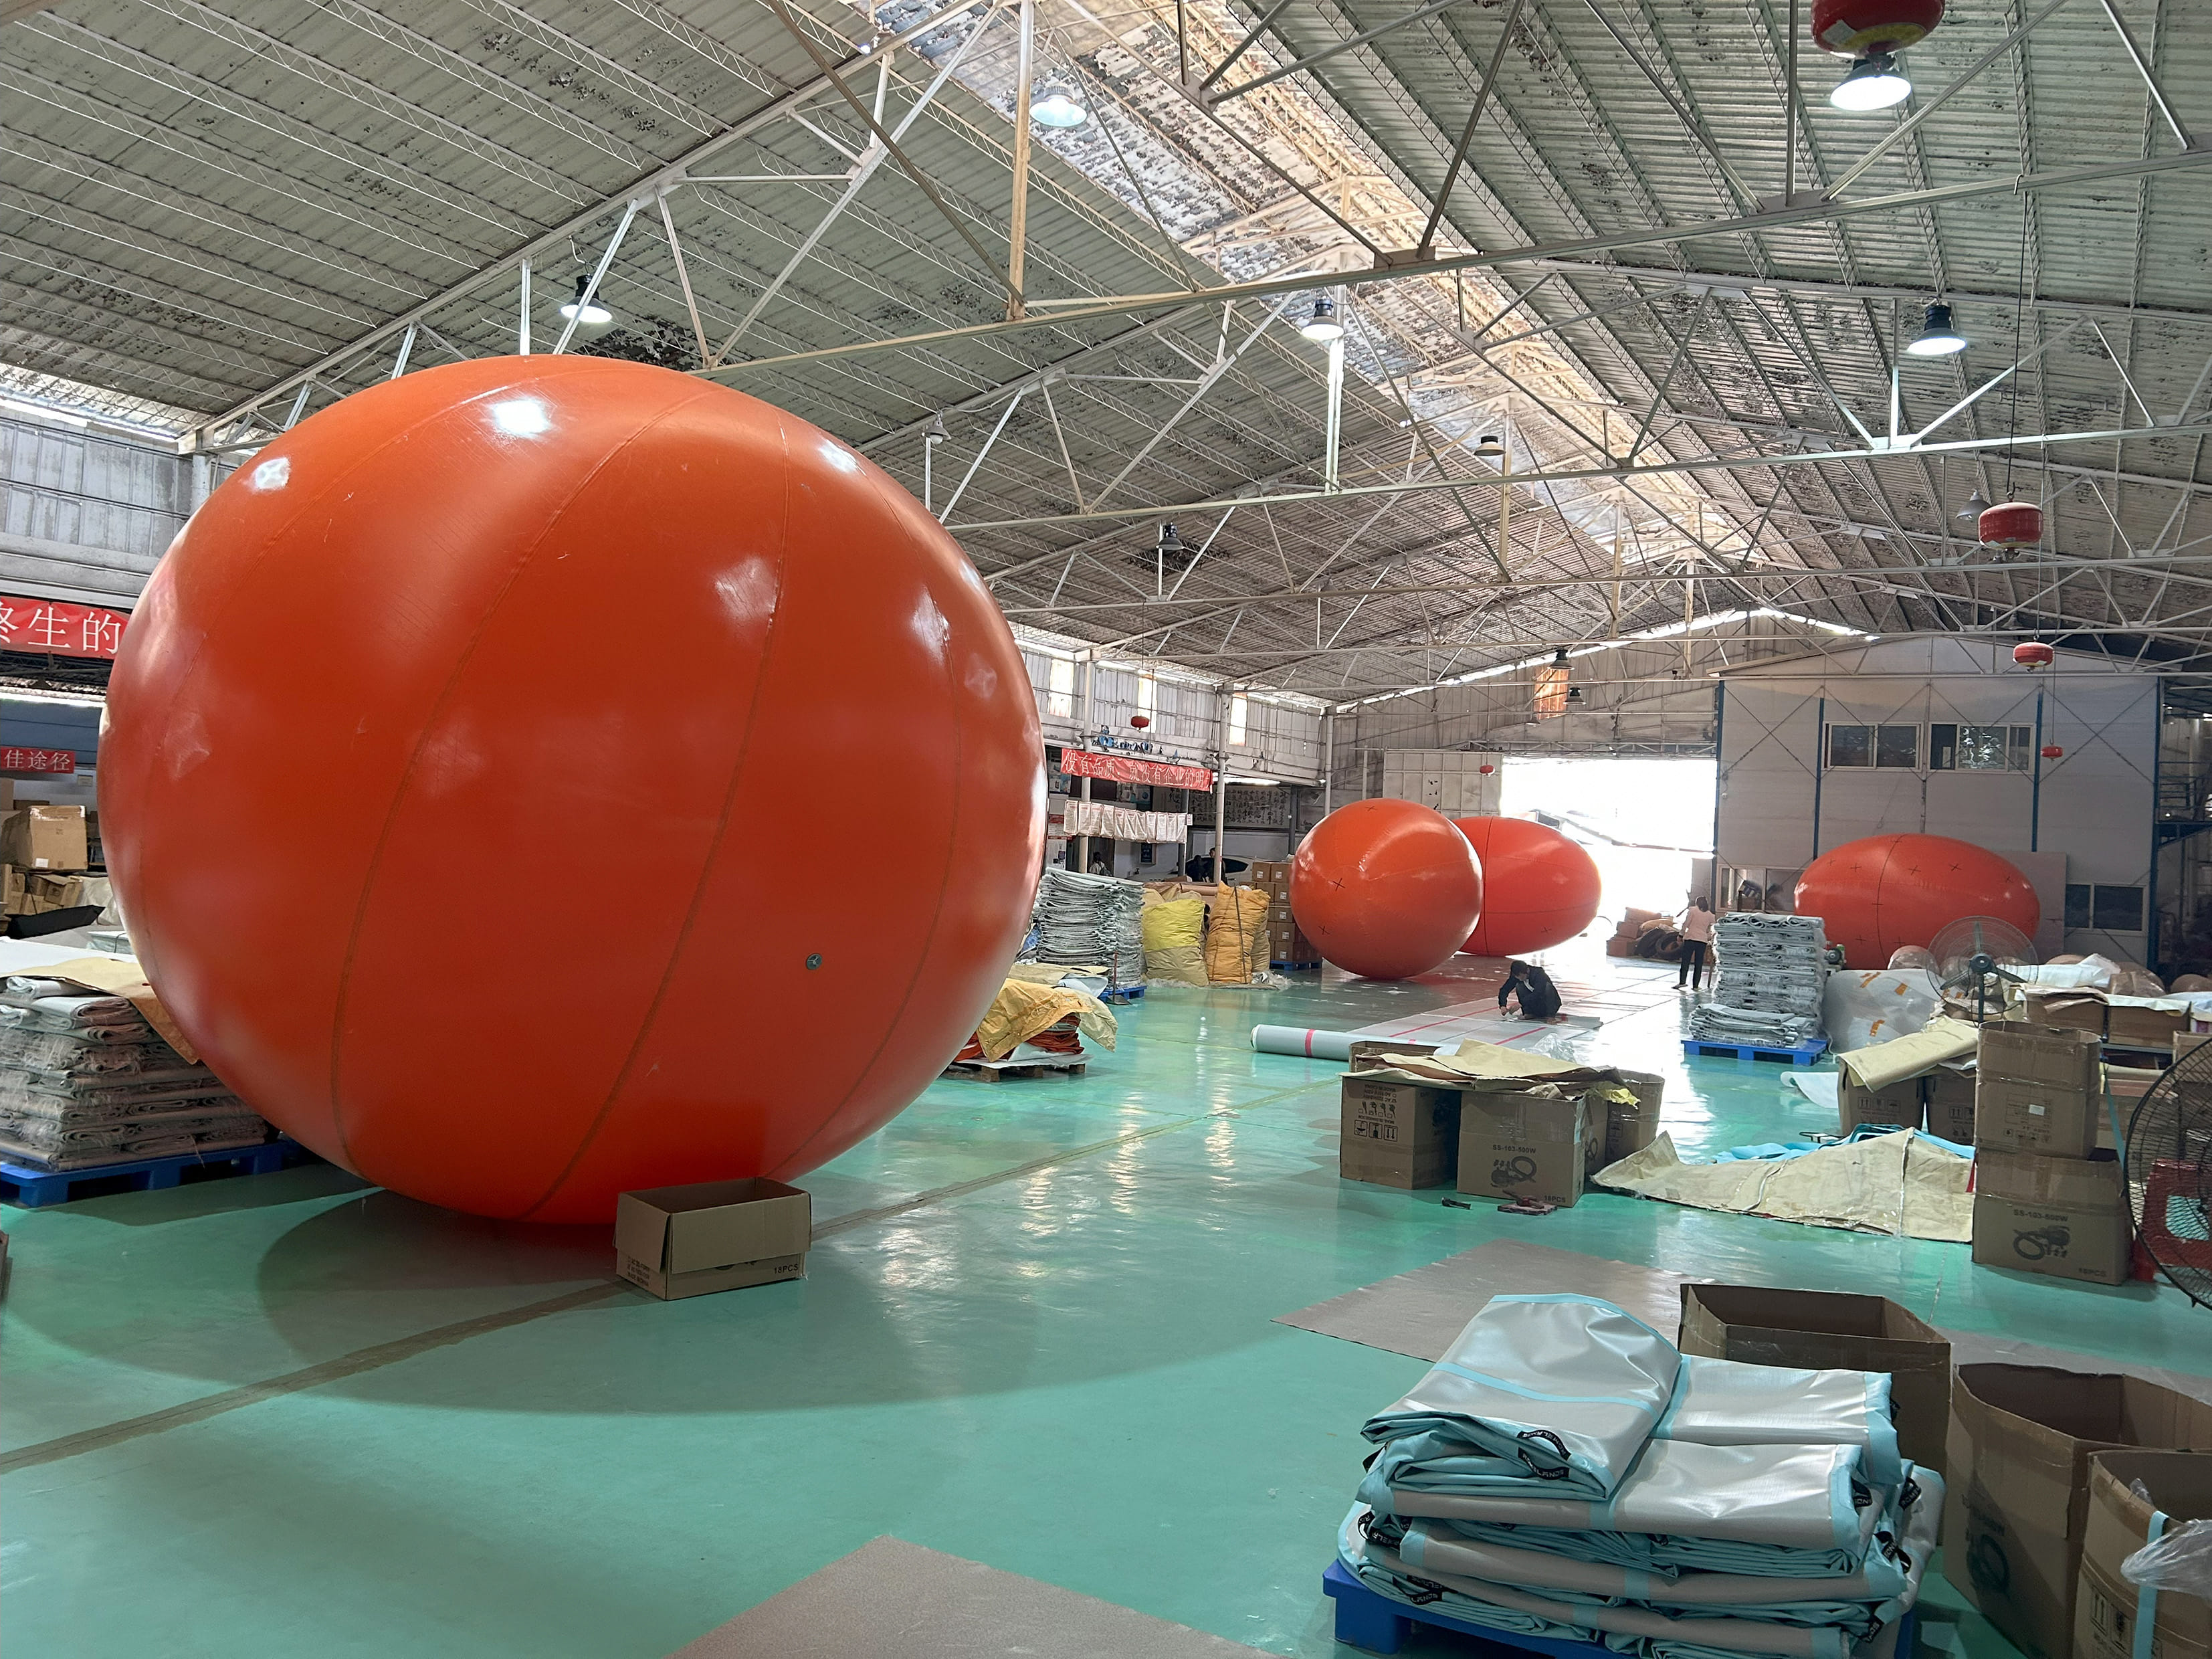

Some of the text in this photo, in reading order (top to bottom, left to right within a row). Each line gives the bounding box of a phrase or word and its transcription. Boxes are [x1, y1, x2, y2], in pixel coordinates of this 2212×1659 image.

[4, 749, 70, 771] 佳途径
[775, 1264, 798, 1274] 18PCS
